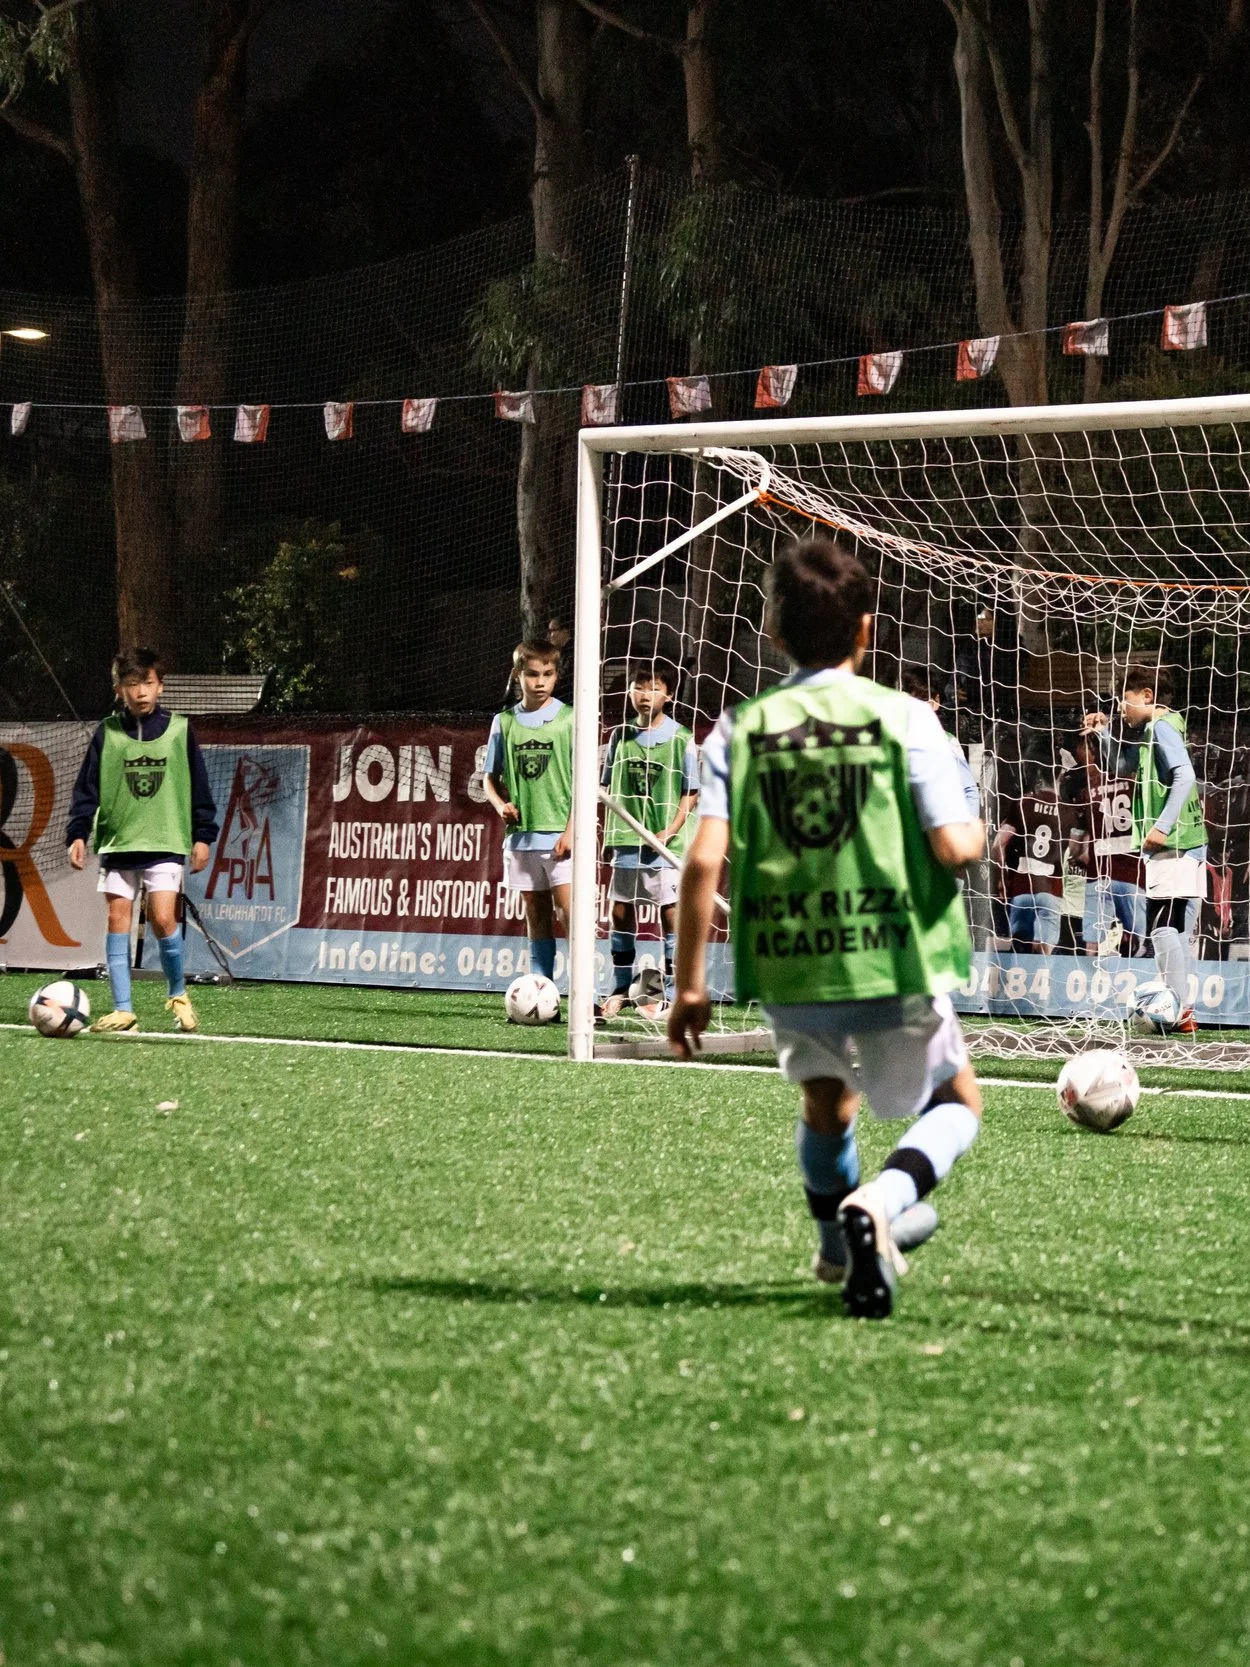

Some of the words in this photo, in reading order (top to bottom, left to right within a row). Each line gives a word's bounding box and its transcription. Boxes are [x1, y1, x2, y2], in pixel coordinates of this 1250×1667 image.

[333, 744, 453, 803] JOIN
[328, 821, 431, 861] AUSTRALIA'S
[435, 823, 484, 862] MOST
[1032, 824, 1053, 859] 8
[215, 904, 271, 921] LEICHHARDT
[324, 877, 393, 916] FAMOUS
[397, 878, 411, 917] &
[414, 879, 491, 920] HISTORIC
[318, 940, 446, 976] Infoline:
[755, 923, 911, 958] ACADEMY
